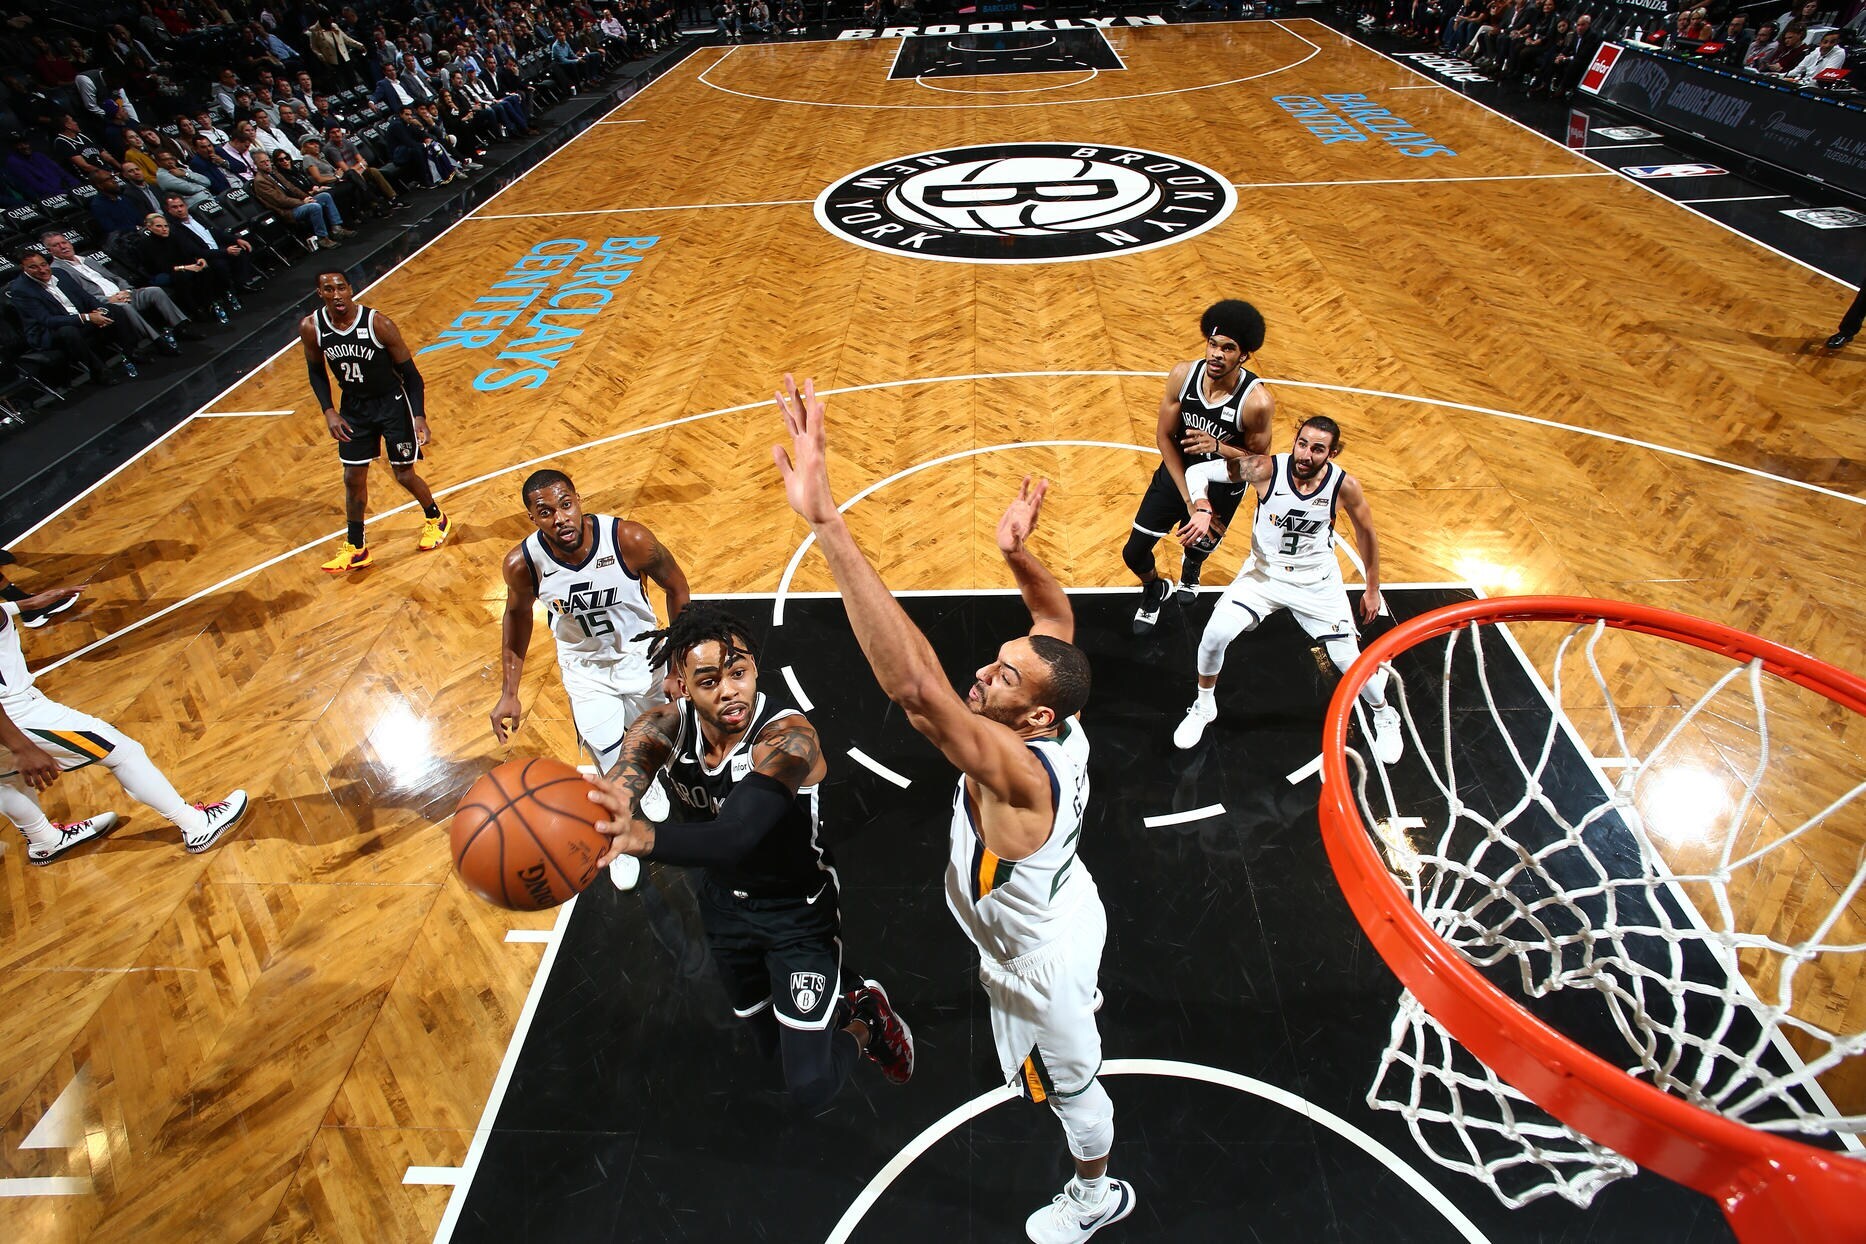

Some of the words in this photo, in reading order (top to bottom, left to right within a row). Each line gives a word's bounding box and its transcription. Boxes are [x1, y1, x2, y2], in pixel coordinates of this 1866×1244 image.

[836, 15, 1168, 41] BROOKLYN
[1391, 52, 1489, 82] jetBlue
[1591, 58, 1610, 75] infor
[1667, 81, 1716, 117] GRUDGE
[1703, 91, 1753, 129] MATCH
[1271, 95, 1368, 145] CENTER
[1321, 93, 1458, 158] BARCLAYS
[1830, 136, 1854, 151] ALL
[1823, 148, 1860, 167] TUESDAY
[851, 155, 950, 191] NEW
[41, 194, 68, 207] QATAR
[72, 184, 97, 196] QATAR
[226, 188, 246, 200] QATAR
[1071, 147, 1216, 247] BROOKLYN
[8, 205, 34, 219] QATAR
[198, 200, 219, 212] QATAR
[836, 199, 944, 249] YORK
[416, 239, 588, 356] CENTER
[472, 236, 661, 391] BARCLAYS
[324, 344, 375, 361] BROOKLYN
[340, 362, 364, 383] 24
[1269, 508, 1325, 534] JAZZ
[1278, 532, 1299, 555] 3
[552, 581, 622, 615] JAZZ
[575, 610, 615, 638] 15
[732, 763, 748, 773] infor
[791, 974, 825, 992] NETS
